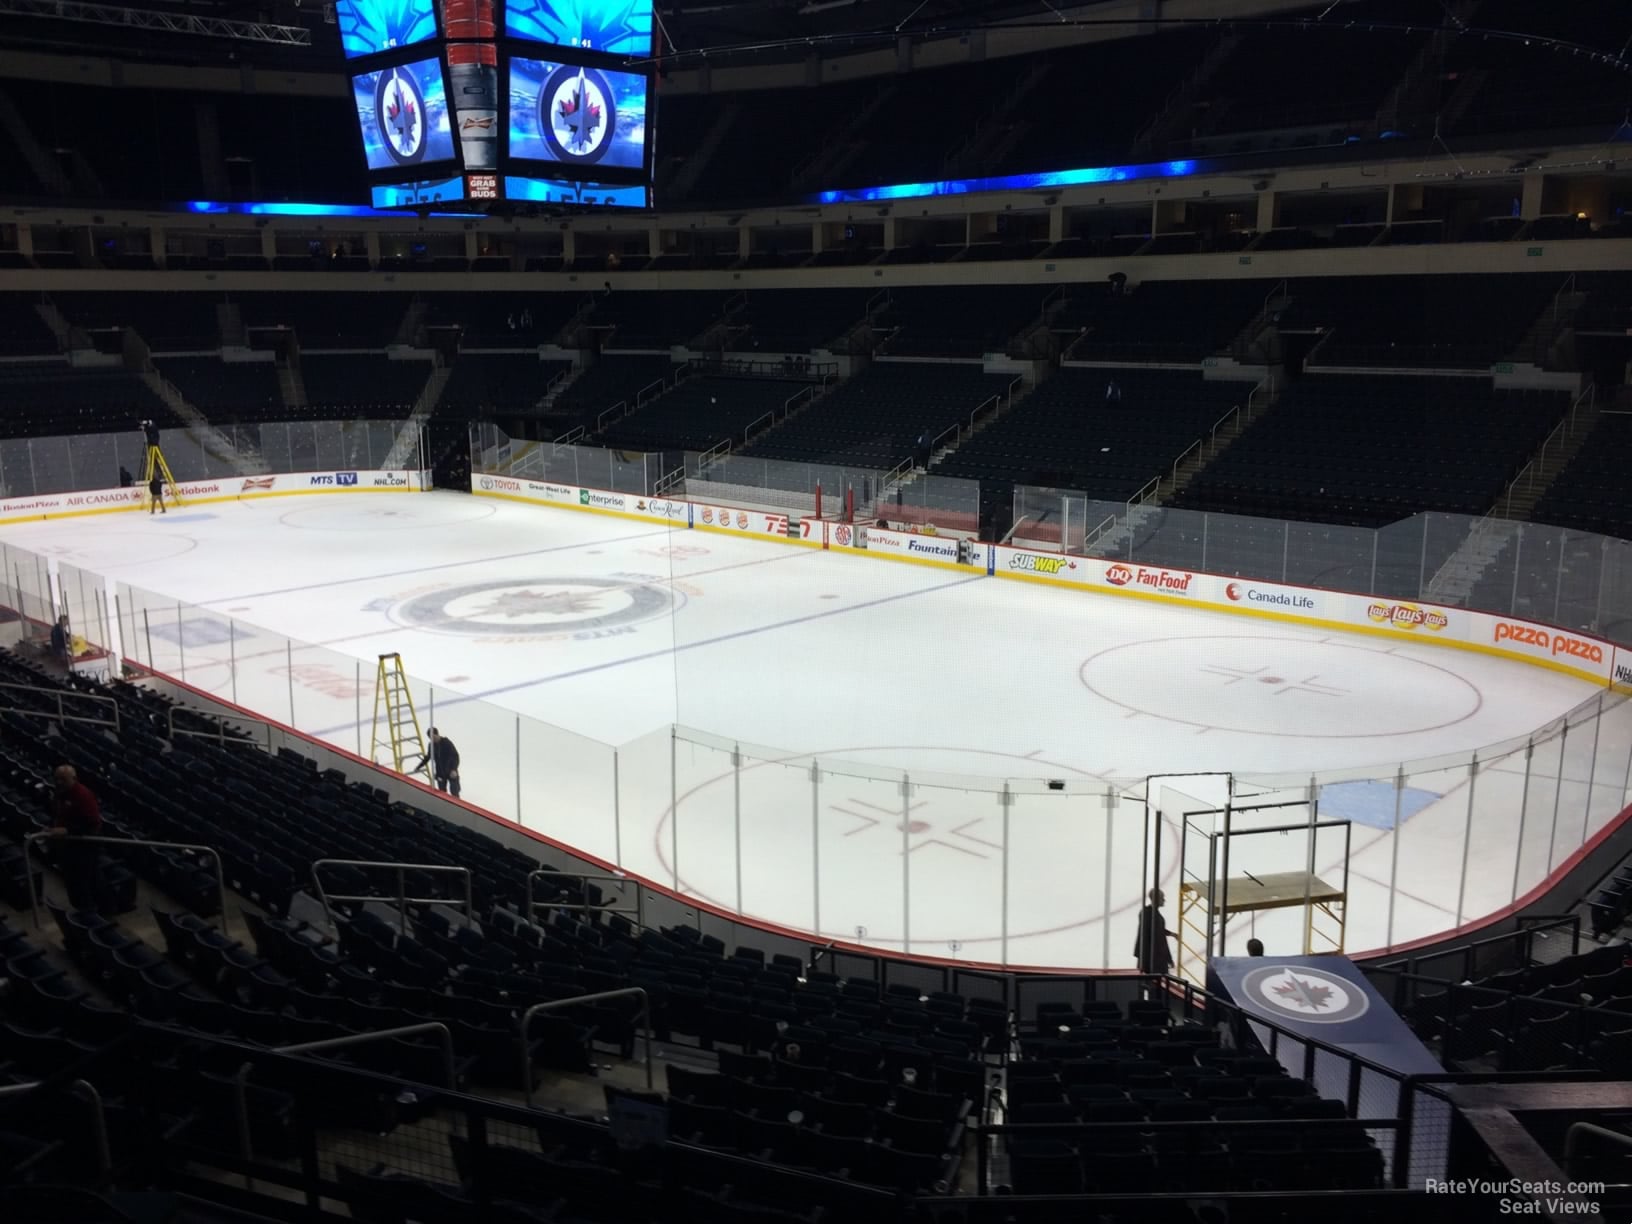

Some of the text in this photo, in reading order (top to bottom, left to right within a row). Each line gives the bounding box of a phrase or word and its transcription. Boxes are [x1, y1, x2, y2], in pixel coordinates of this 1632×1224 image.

[470, 190, 496, 198] BUDS
[311, 473, 355, 485] MTS TV
[374, 478, 406, 486] NHL.COM
[494, 479, 521, 491] TOYOTA
[67, 493, 129, 505] AIR CANADA
[908, 540, 958, 556] Fountain
[1009, 553, 1067, 574] SUBWAY
[1247, 589, 1314, 608] Canada Life
[1494, 622, 1603, 664] pizza pizza
